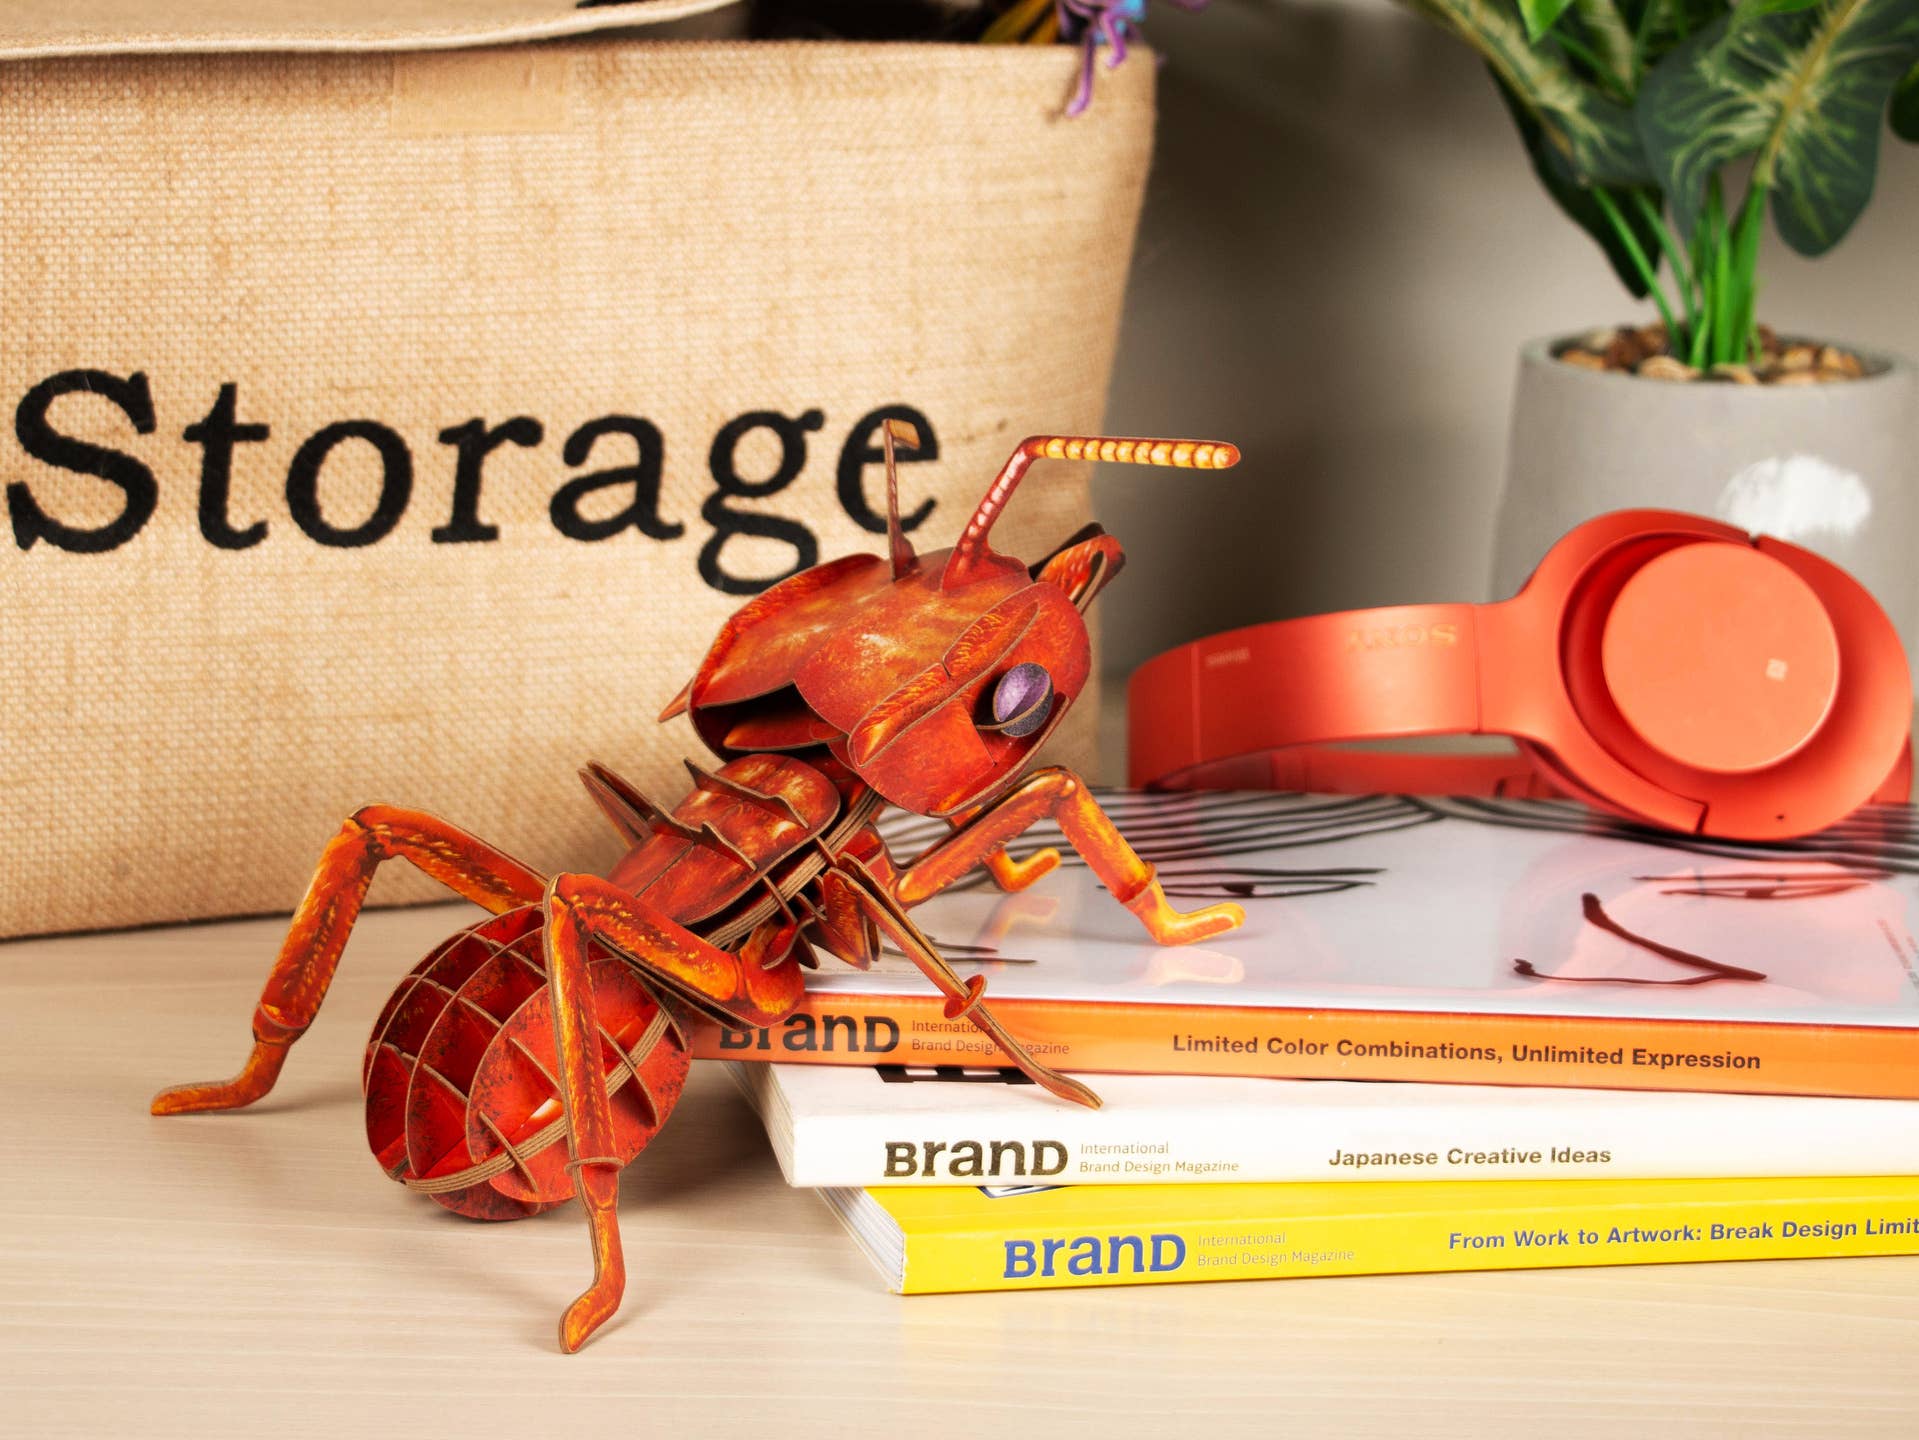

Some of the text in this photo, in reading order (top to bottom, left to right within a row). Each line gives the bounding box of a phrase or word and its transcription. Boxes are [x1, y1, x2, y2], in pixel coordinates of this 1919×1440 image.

[6, 368, 939, 596] Storage
[911, 1019, 983, 1034] Internatio
[911, 1038, 952, 1051] Brand
[1021, 1041, 1070, 1056] gazine
[1172, 1034, 1761, 1070] Limited Color Combinations, Unlimited Expression
[1080, 1140, 1170, 1155] International
[1328, 1146, 1612, 1169] Japanese Creative Ideas
[1079, 1160, 1240, 1176] Brand Design Magazine
[1197, 1231, 1287, 1247] International
[1449, 1231, 1505, 1250] From
[1513, 1229, 1569, 1247] Work
[1577, 1228, 1600, 1246] to
[1606, 1224, 1702, 1244] Artwork:
[1710, 1222, 1774, 1241] Break
[1782, 1219, 1858, 1240] Design
[1197, 1249, 1356, 1267] Brand Design Magazine
